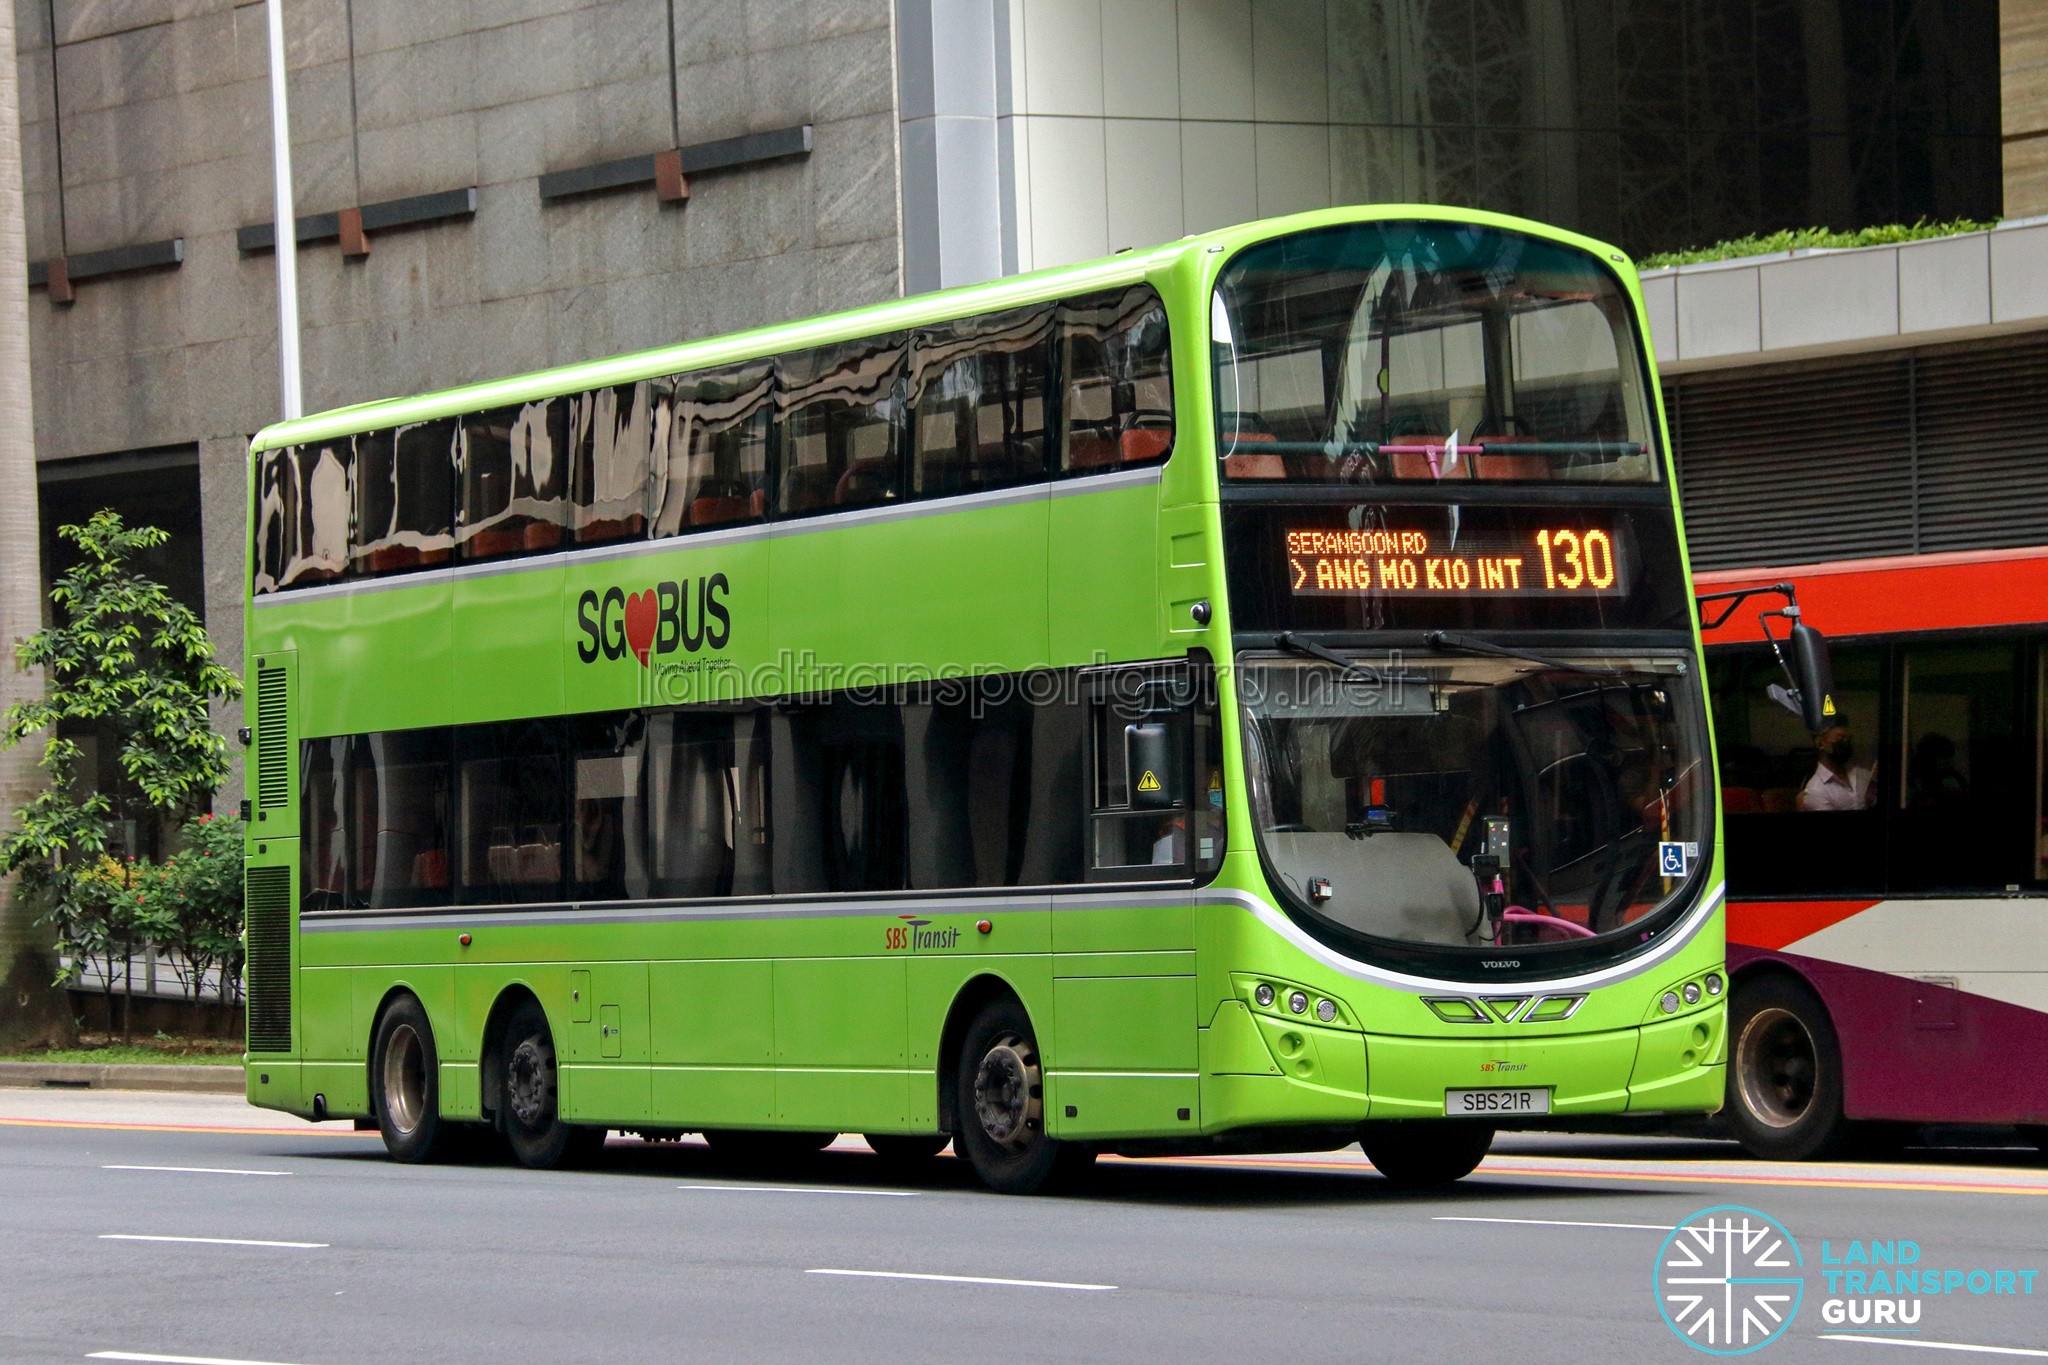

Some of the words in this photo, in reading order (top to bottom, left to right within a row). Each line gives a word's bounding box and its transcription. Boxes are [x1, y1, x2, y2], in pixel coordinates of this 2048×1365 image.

[1287, 532, 1400, 555] SERANGOON
[1400, 532, 1427, 555] RD
[1535, 529, 1614, 590] 130
[1316, 558, 1371, 590] ANG
[1378, 558, 1418, 590] MO
[1425, 558, 1471, 590] KIO
[1477, 558, 1522, 590] INT
[654, 662, 678, 679] Moving
[679, 659, 701, 675] Ahead
[702, 655, 731, 675] Together
[886, 927, 908, 950] SBS
[906, 920, 961, 954] Transit
[1481, 960, 1521, 969] VOLVO
[1480, 1063, 1495, 1072] SBS
[1495, 1061, 1528, 1073] Transit
[1463, 1092, 1531, 1111] SBS21R
